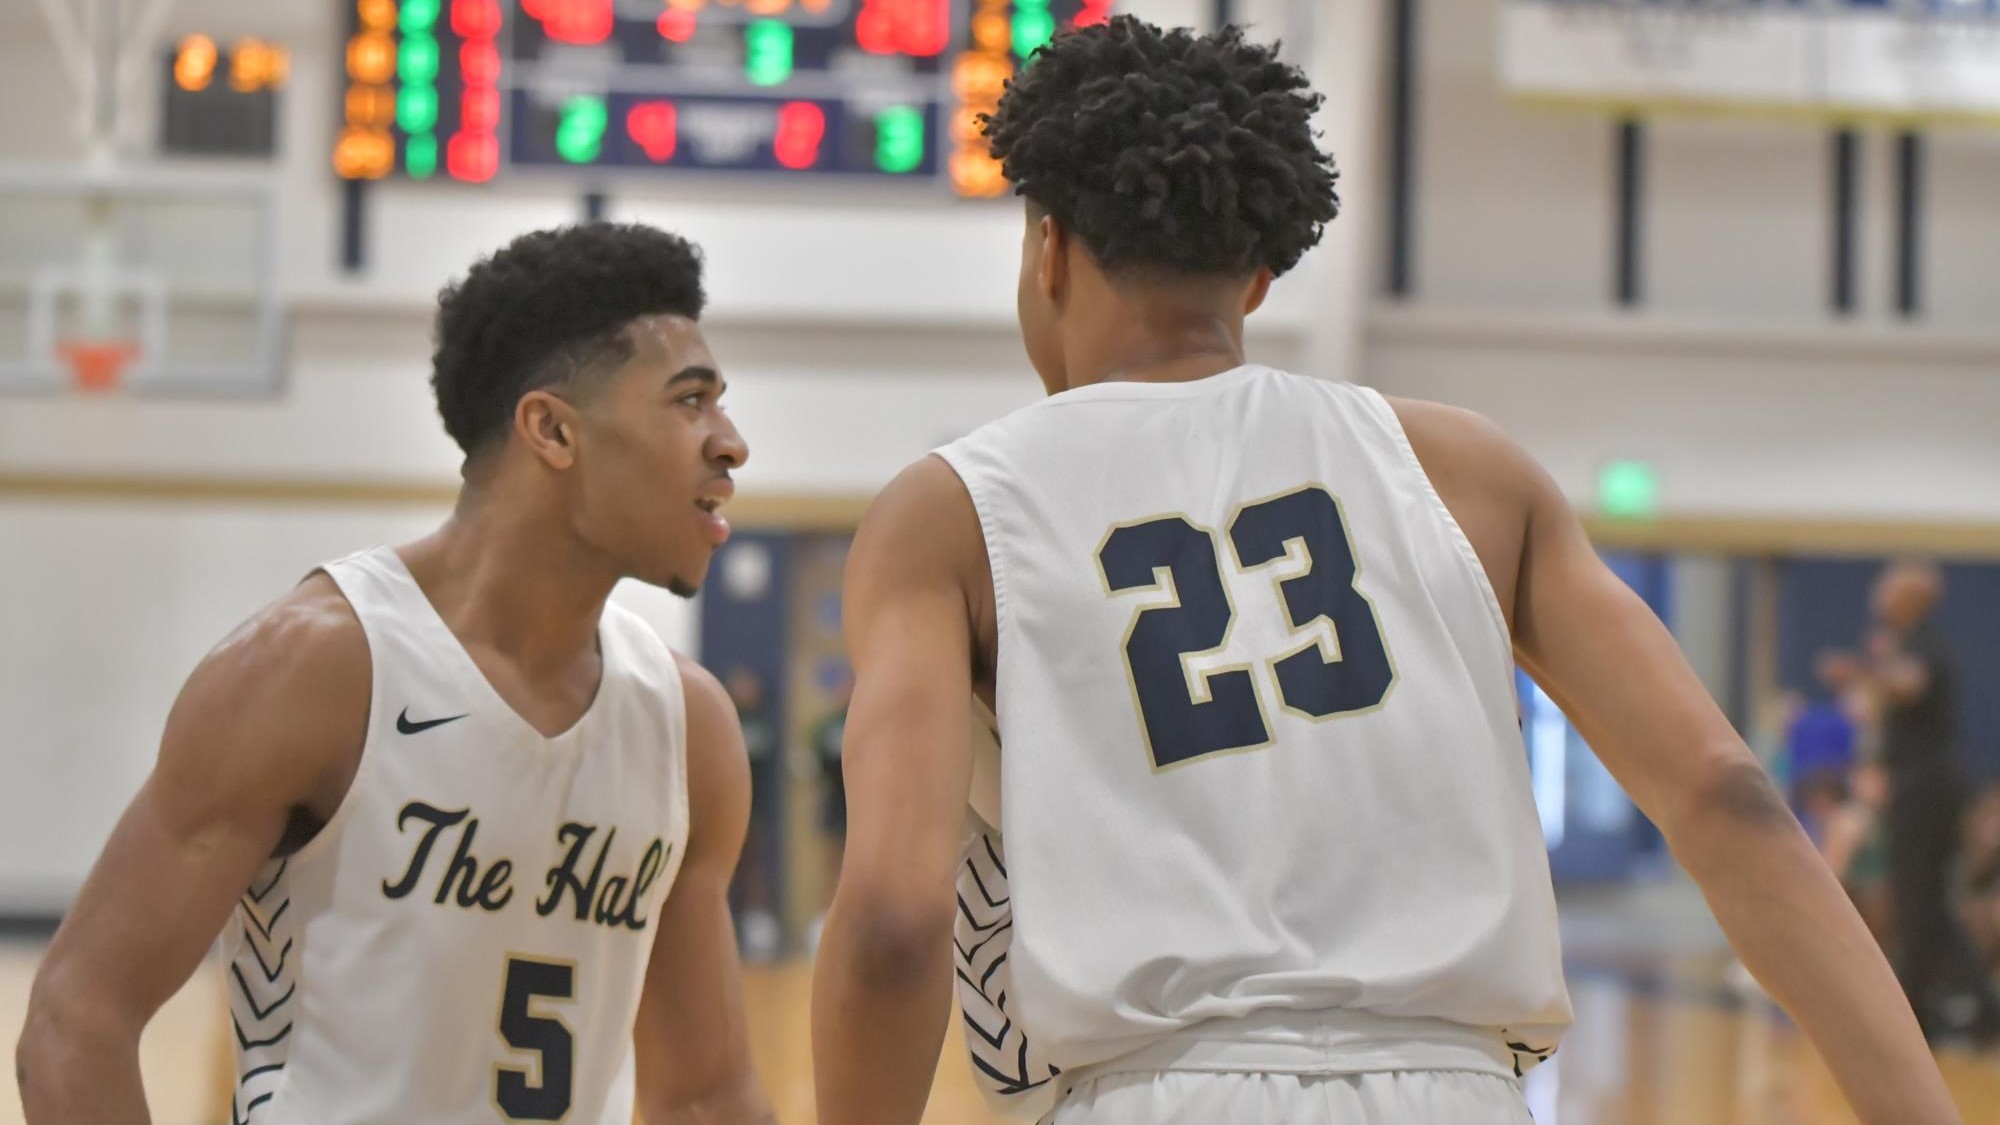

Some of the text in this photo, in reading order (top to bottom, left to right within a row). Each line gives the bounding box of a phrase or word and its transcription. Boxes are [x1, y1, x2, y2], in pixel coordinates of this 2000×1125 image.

[1093, 480, 1400, 774] 23
[380, 800, 673, 931] The Hal
[491, 950, 579, 1123] 5
